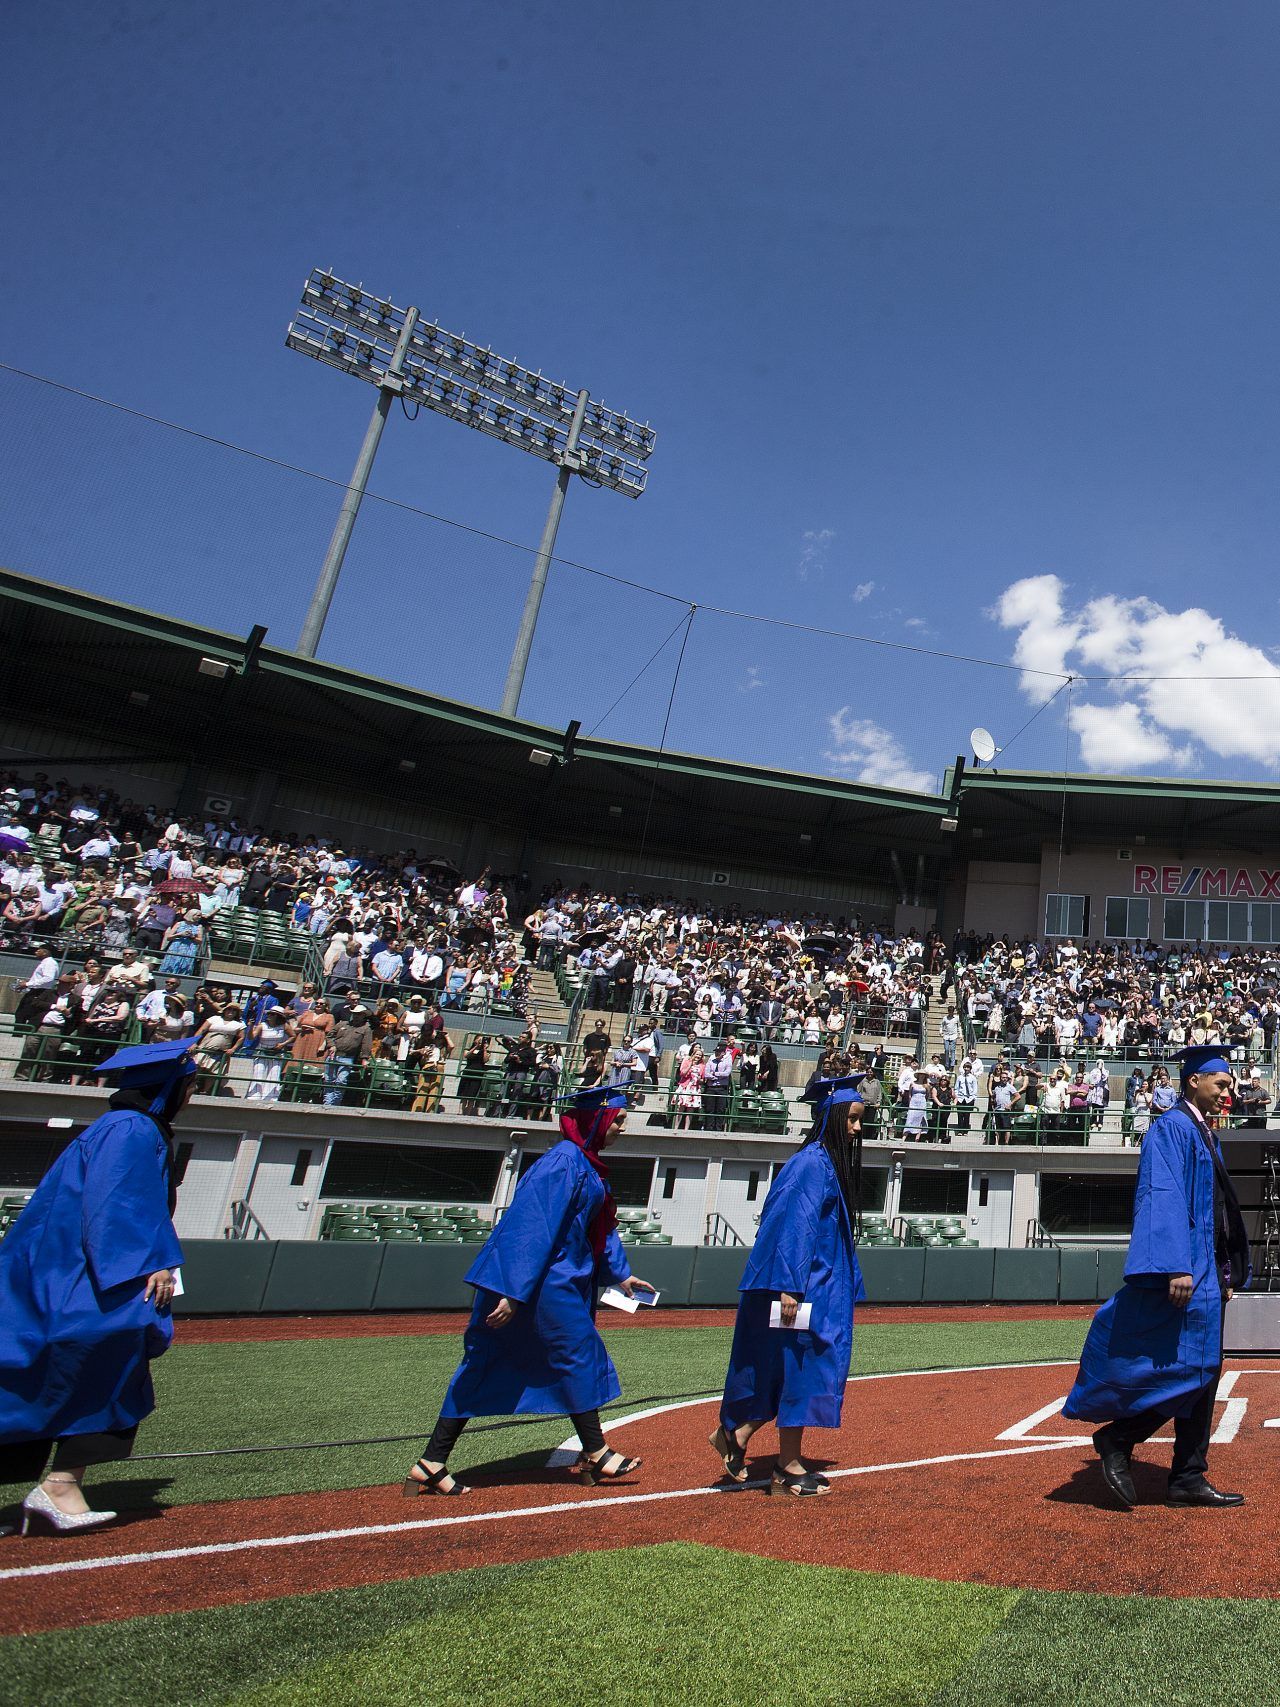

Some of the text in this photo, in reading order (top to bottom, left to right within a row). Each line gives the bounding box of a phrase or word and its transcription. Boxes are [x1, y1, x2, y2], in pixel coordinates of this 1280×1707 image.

[209, 800, 226, 812] C
[1120, 850, 1130, 859] E
[715, 873, 728, 883] D
